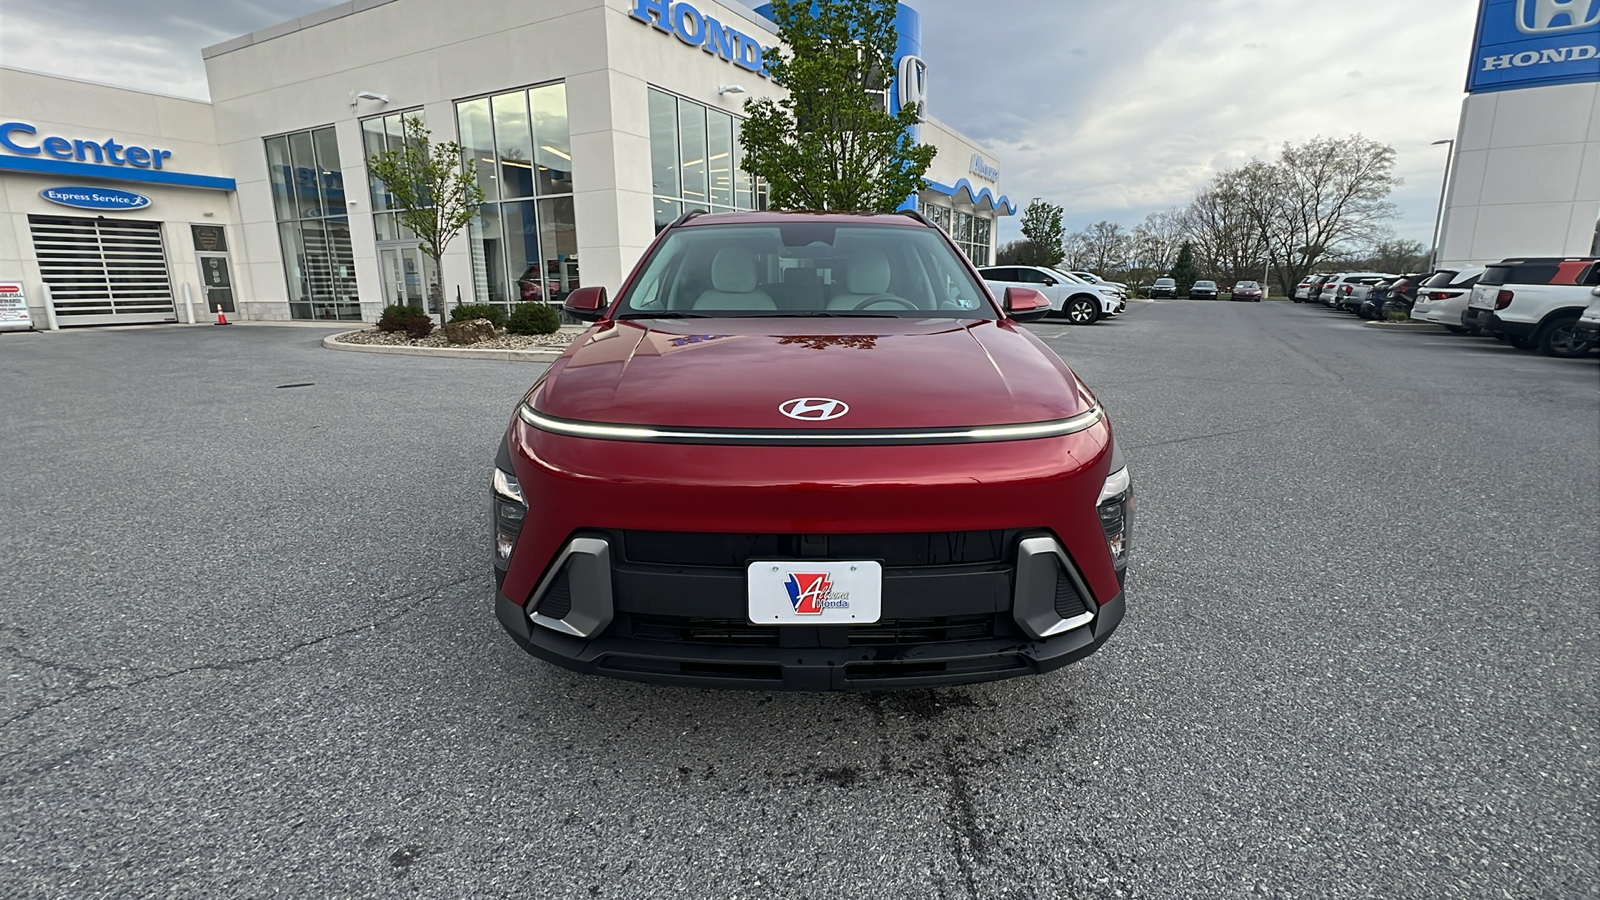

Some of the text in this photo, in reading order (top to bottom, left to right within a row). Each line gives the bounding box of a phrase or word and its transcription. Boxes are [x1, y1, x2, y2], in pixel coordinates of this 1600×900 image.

[1481, 45, 1600, 71] HOND
[0, 122, 171, 169] Center
[48, 190, 130, 204] Express Service
[817, 599, 849, 608] Honda
